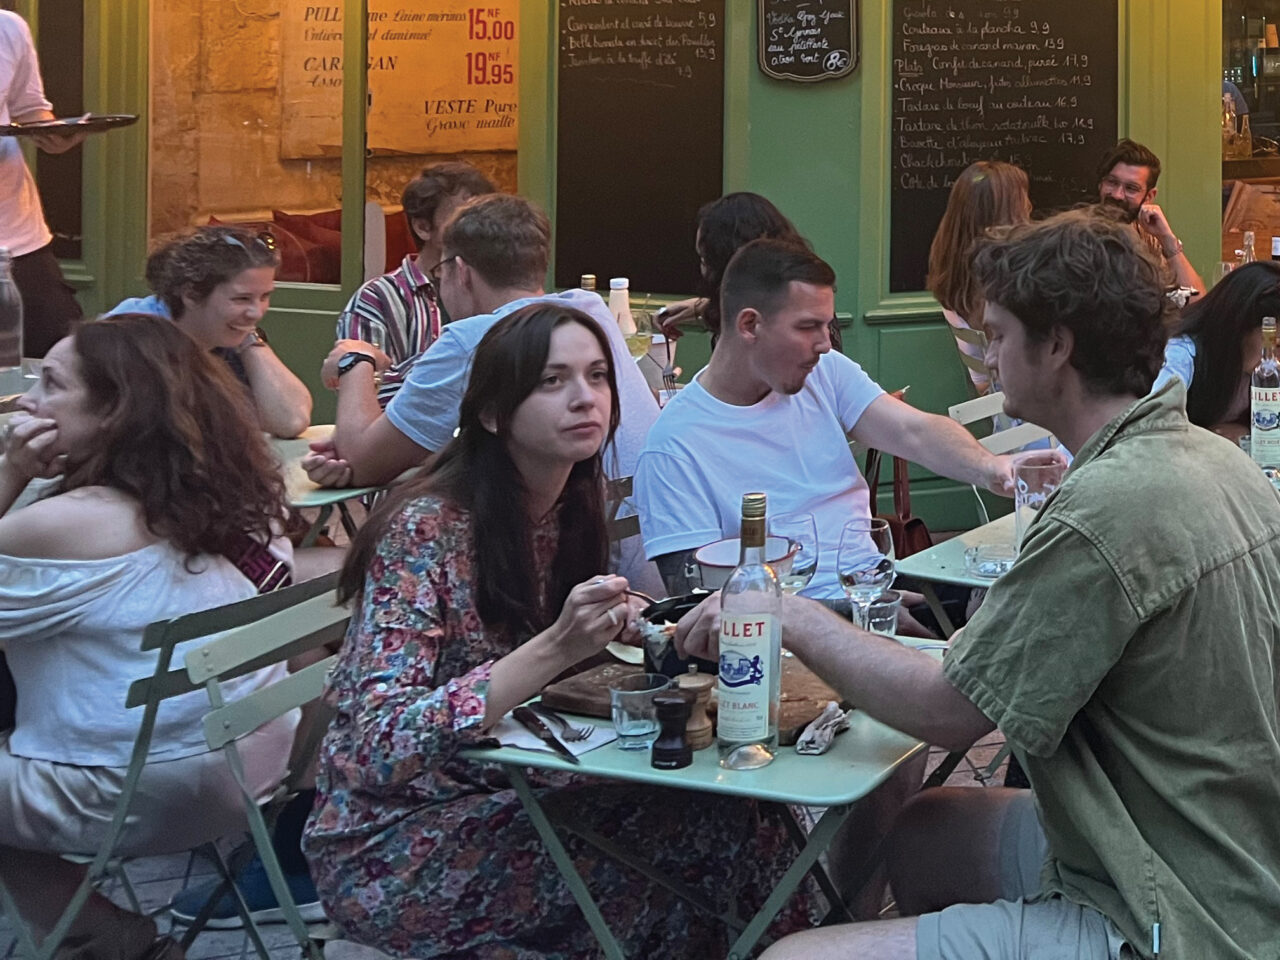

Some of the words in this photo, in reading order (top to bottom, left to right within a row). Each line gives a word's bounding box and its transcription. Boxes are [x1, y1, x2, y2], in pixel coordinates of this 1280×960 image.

[303, 6, 342, 22] PULL
[487, 8, 501, 19] NF
[468, 7, 515, 41] 15.00
[488, 52, 501, 62] NF
[465, 51, 514, 86] 19.95
[424, 99, 477, 115] VESTE
[484, 100, 518, 117] Pure
